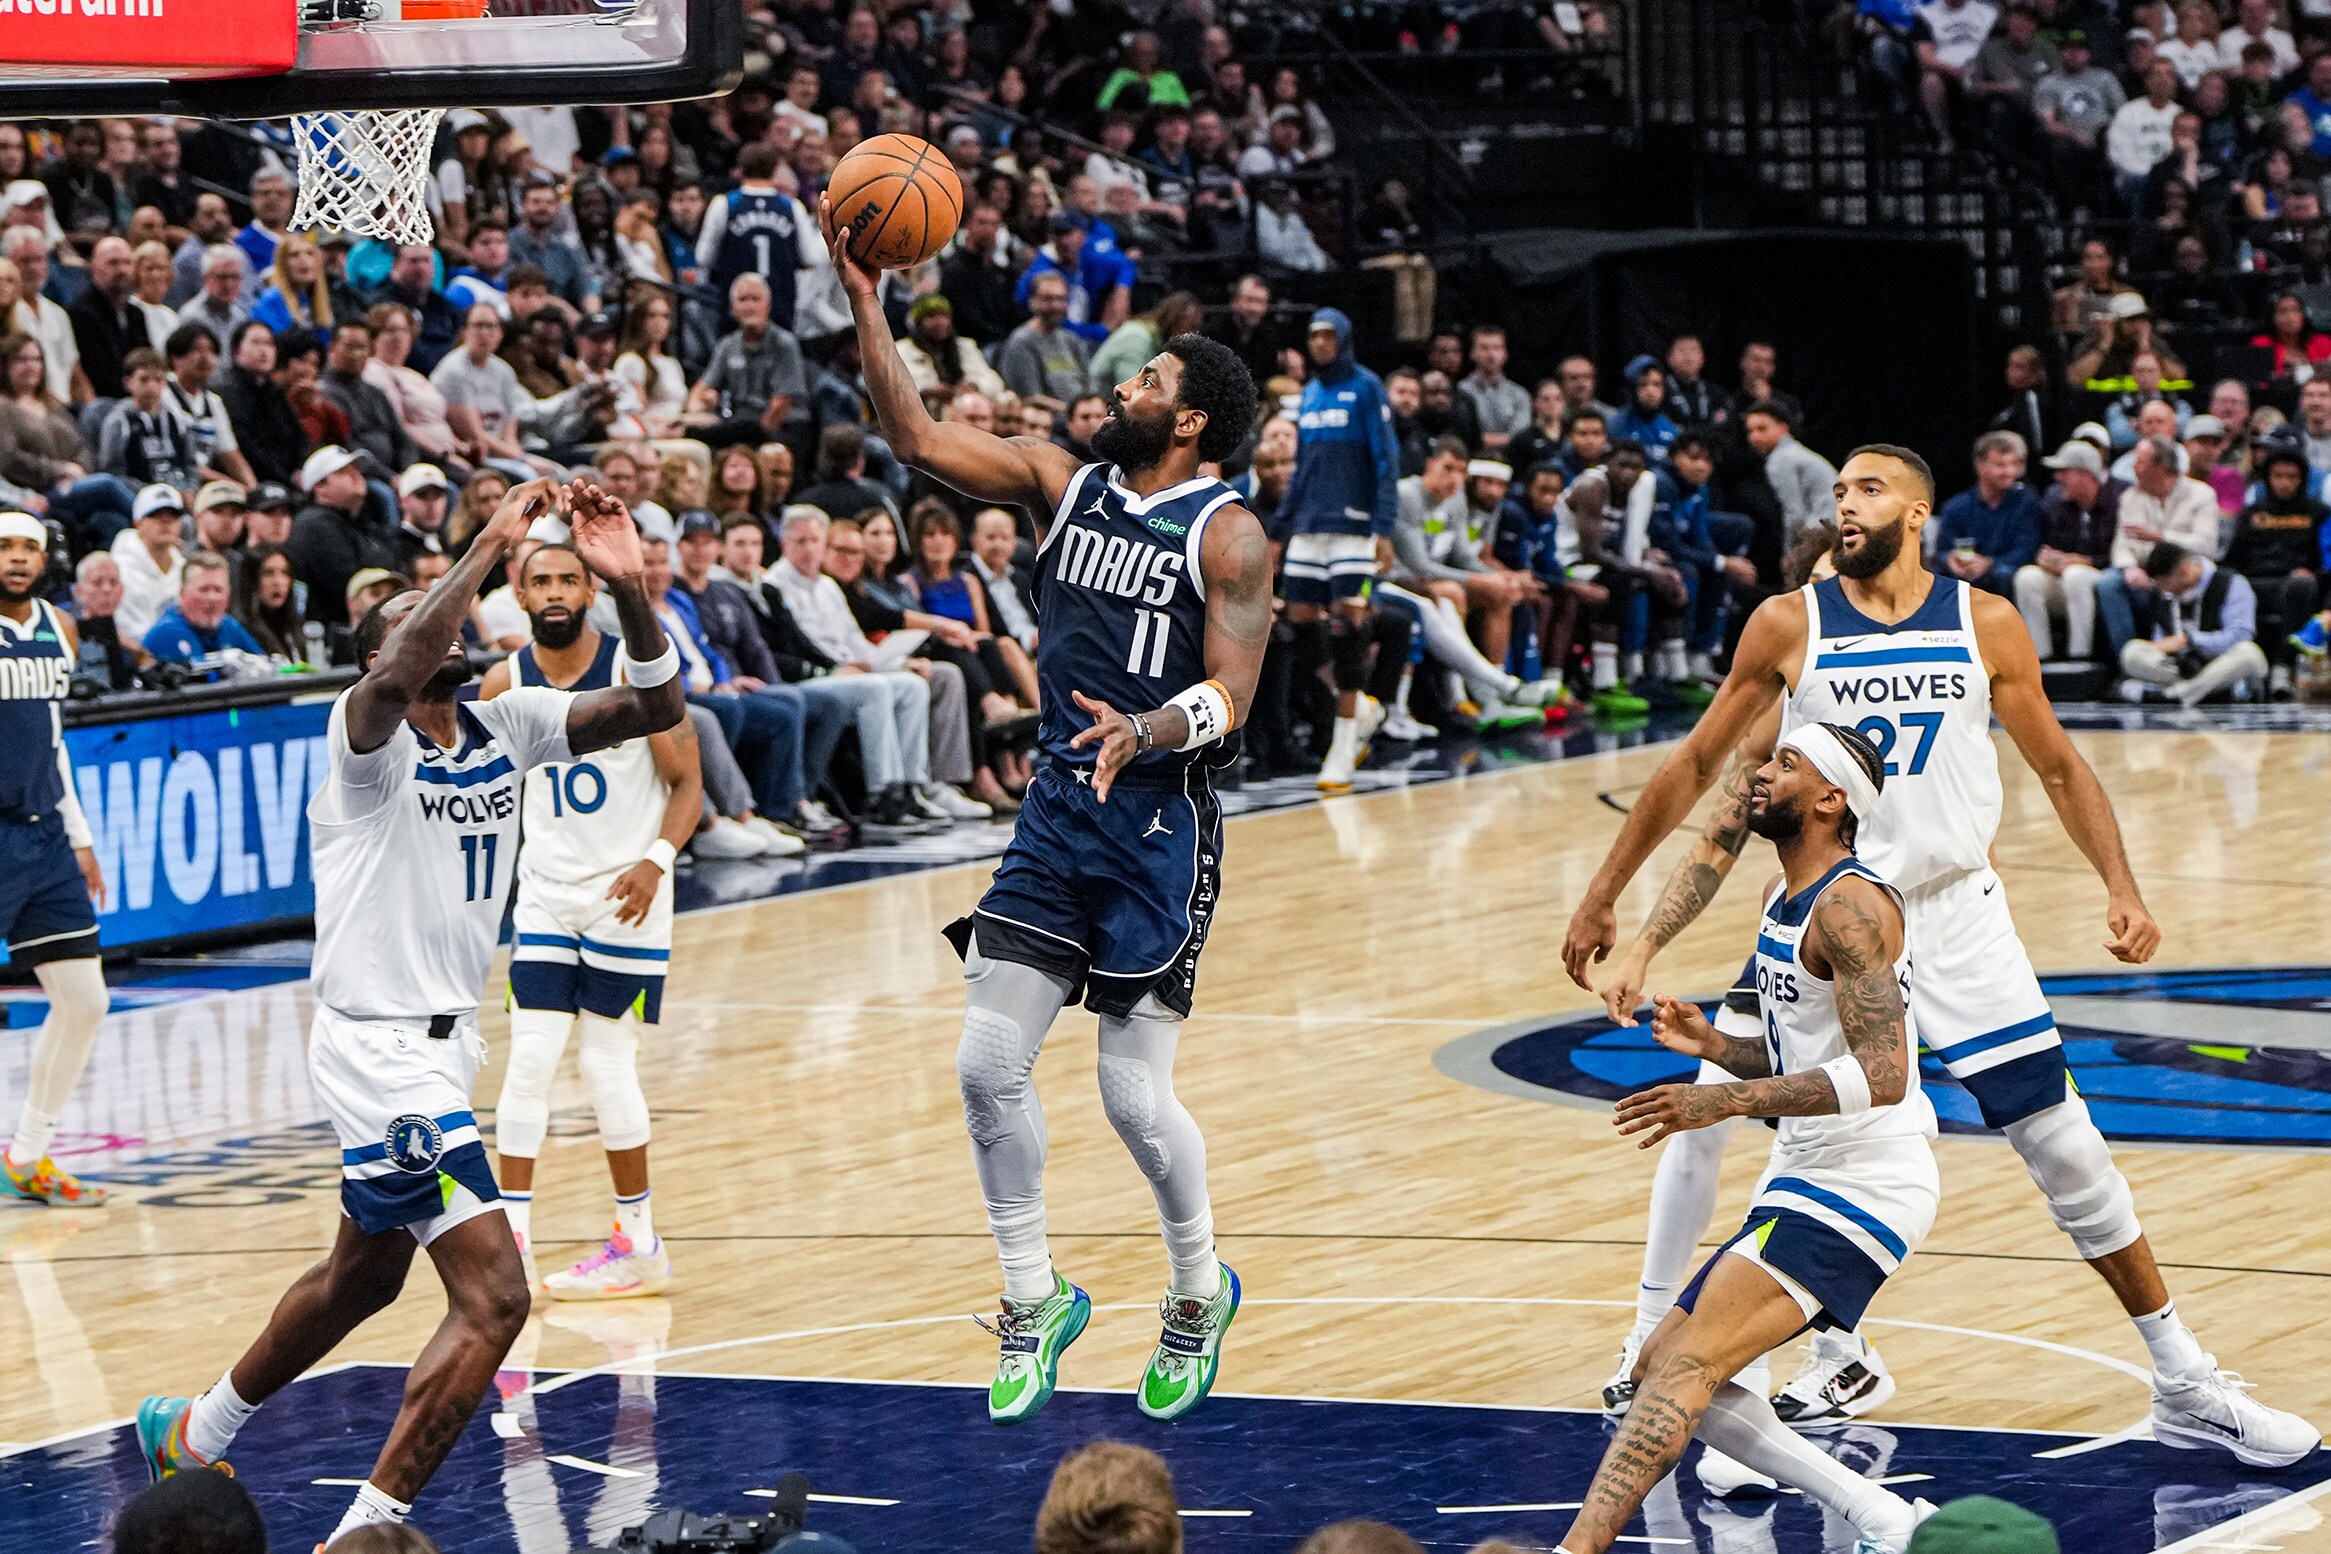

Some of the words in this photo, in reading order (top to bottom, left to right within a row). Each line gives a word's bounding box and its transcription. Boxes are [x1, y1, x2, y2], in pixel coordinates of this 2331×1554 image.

[752, 234, 770, 278] 1
[1148, 516, 1187, 536] chime
[1126, 607, 1172, 679] 11
[1828, 673, 1966, 706] WOLVES
[1854, 711, 1945, 777] 27
[418, 785, 514, 825] WOLVES
[544, 762, 608, 819] 10
[460, 833, 499, 902] 11
